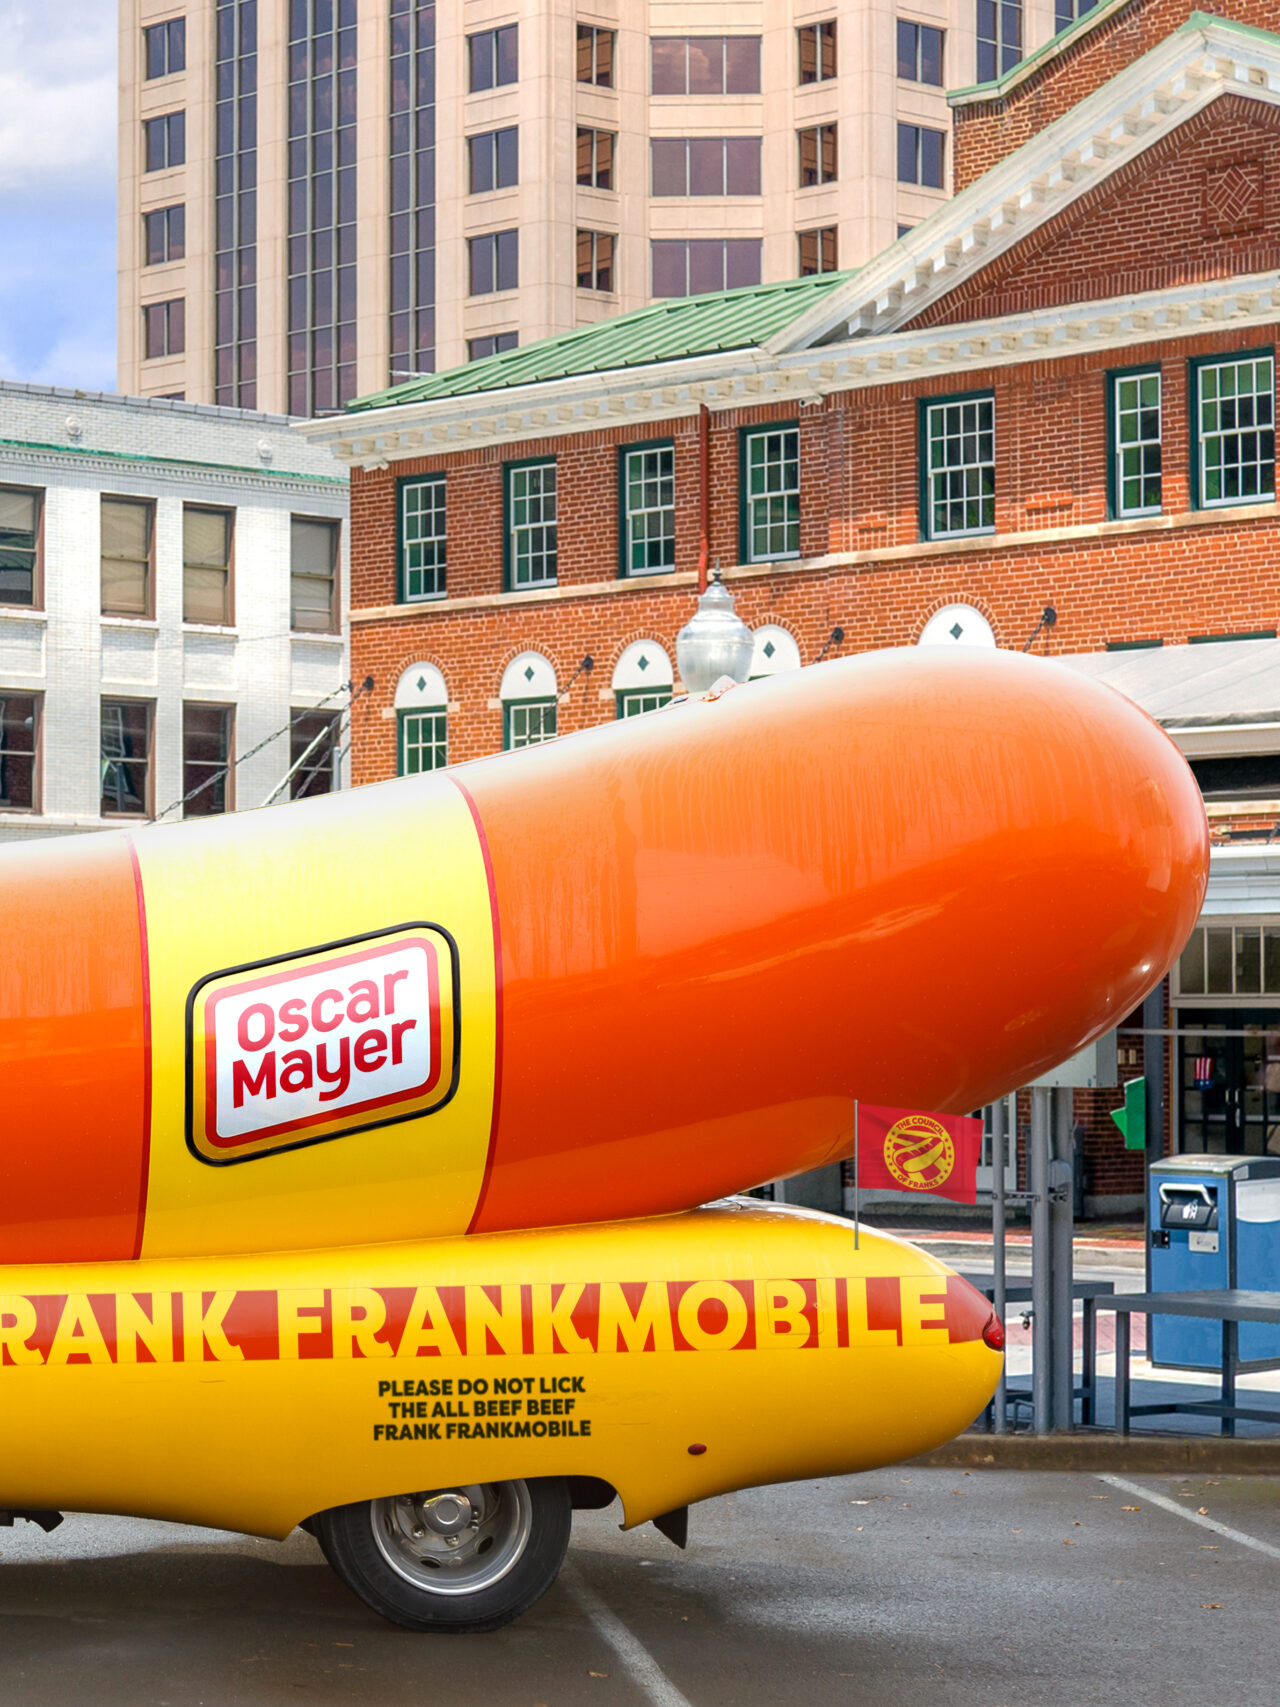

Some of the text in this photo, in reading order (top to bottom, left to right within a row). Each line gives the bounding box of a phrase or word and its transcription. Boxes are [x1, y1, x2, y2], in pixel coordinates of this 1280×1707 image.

[237, 969, 409, 1052] Oscar
[232, 1019, 417, 1109] Mayer
[896, 1117, 944, 1137] THE COUNCIL
[897, 1174, 939, 1188] OF FRANKS
[277, 1276, 950, 1360] FRANKMOBILE
[378, 1376, 586, 1397] PLEASE DO NOT LICK
[388, 1399, 576, 1418] THE ALL BEEF BEEF
[373, 1420, 592, 1441] FRANK FRANKMOBILE
